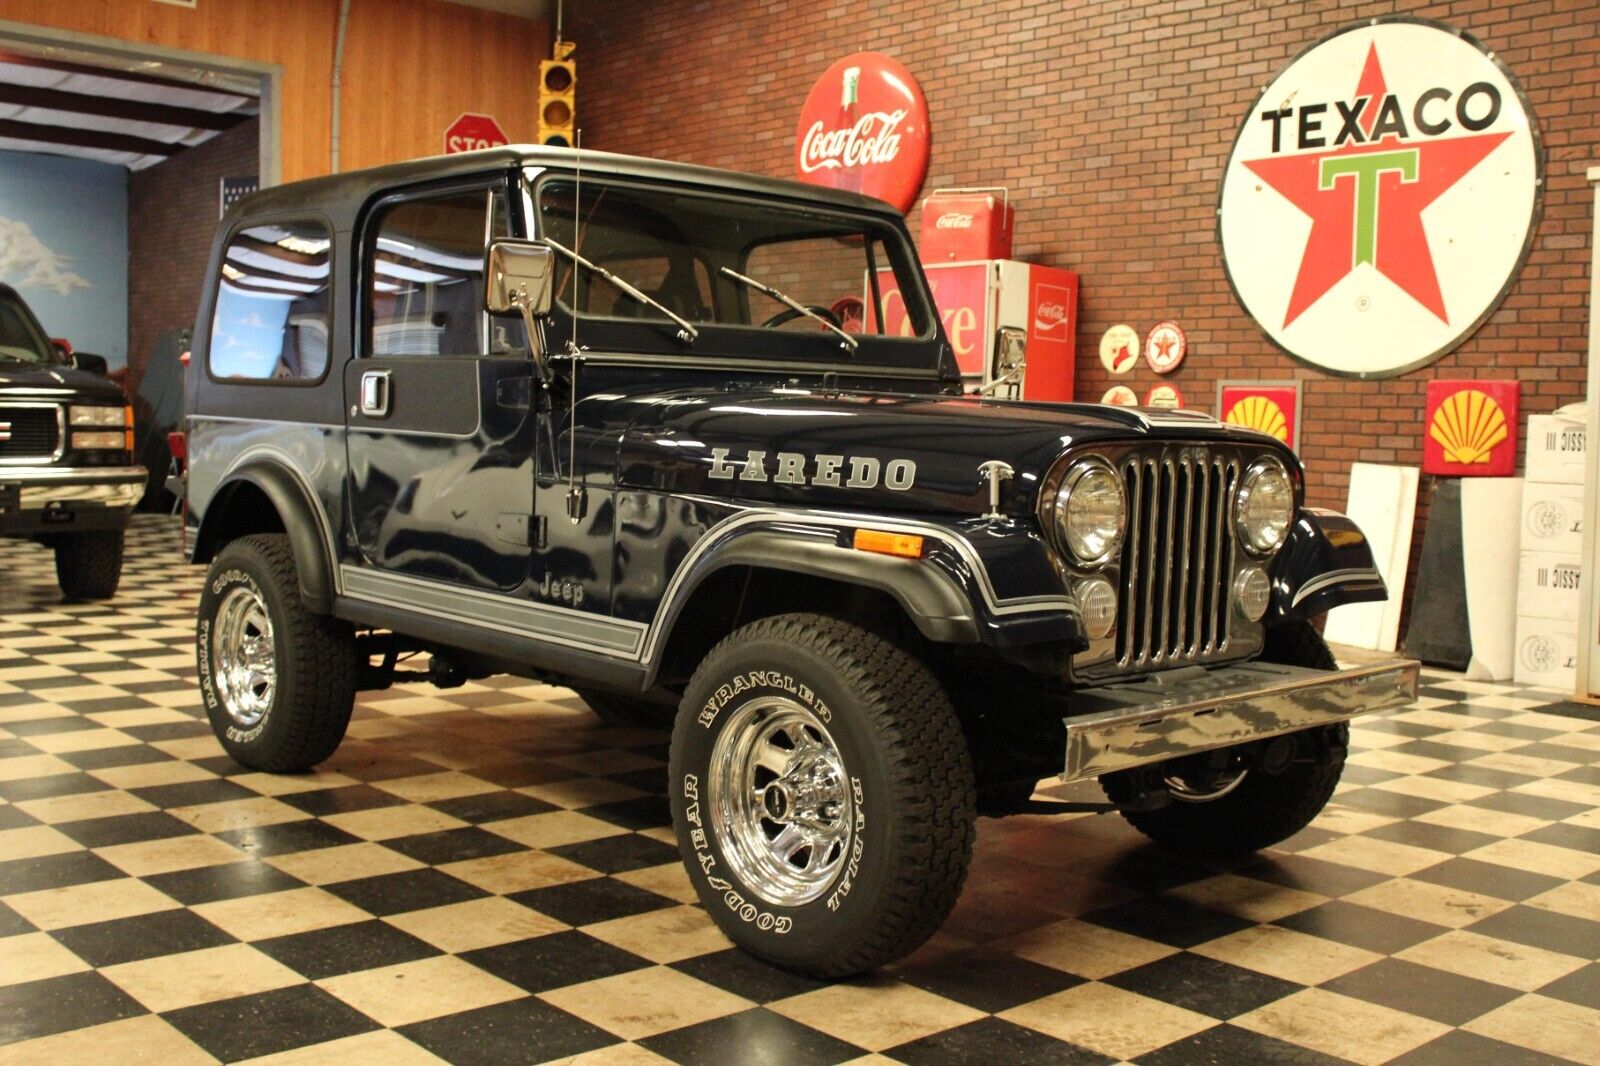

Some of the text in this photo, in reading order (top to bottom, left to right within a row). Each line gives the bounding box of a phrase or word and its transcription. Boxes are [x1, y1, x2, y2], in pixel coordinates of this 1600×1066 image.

[800, 109, 908, 173] Coca-Cola
[1262, 81, 1502, 153] TEXACO
[708, 448, 917, 491] LAREDO
[1561, 432, 1587, 452] SSIC
[540, 571, 584, 607] Jeep
[698, 671, 832, 729] WRANGLER
[826, 776, 865, 912] RADIAL
